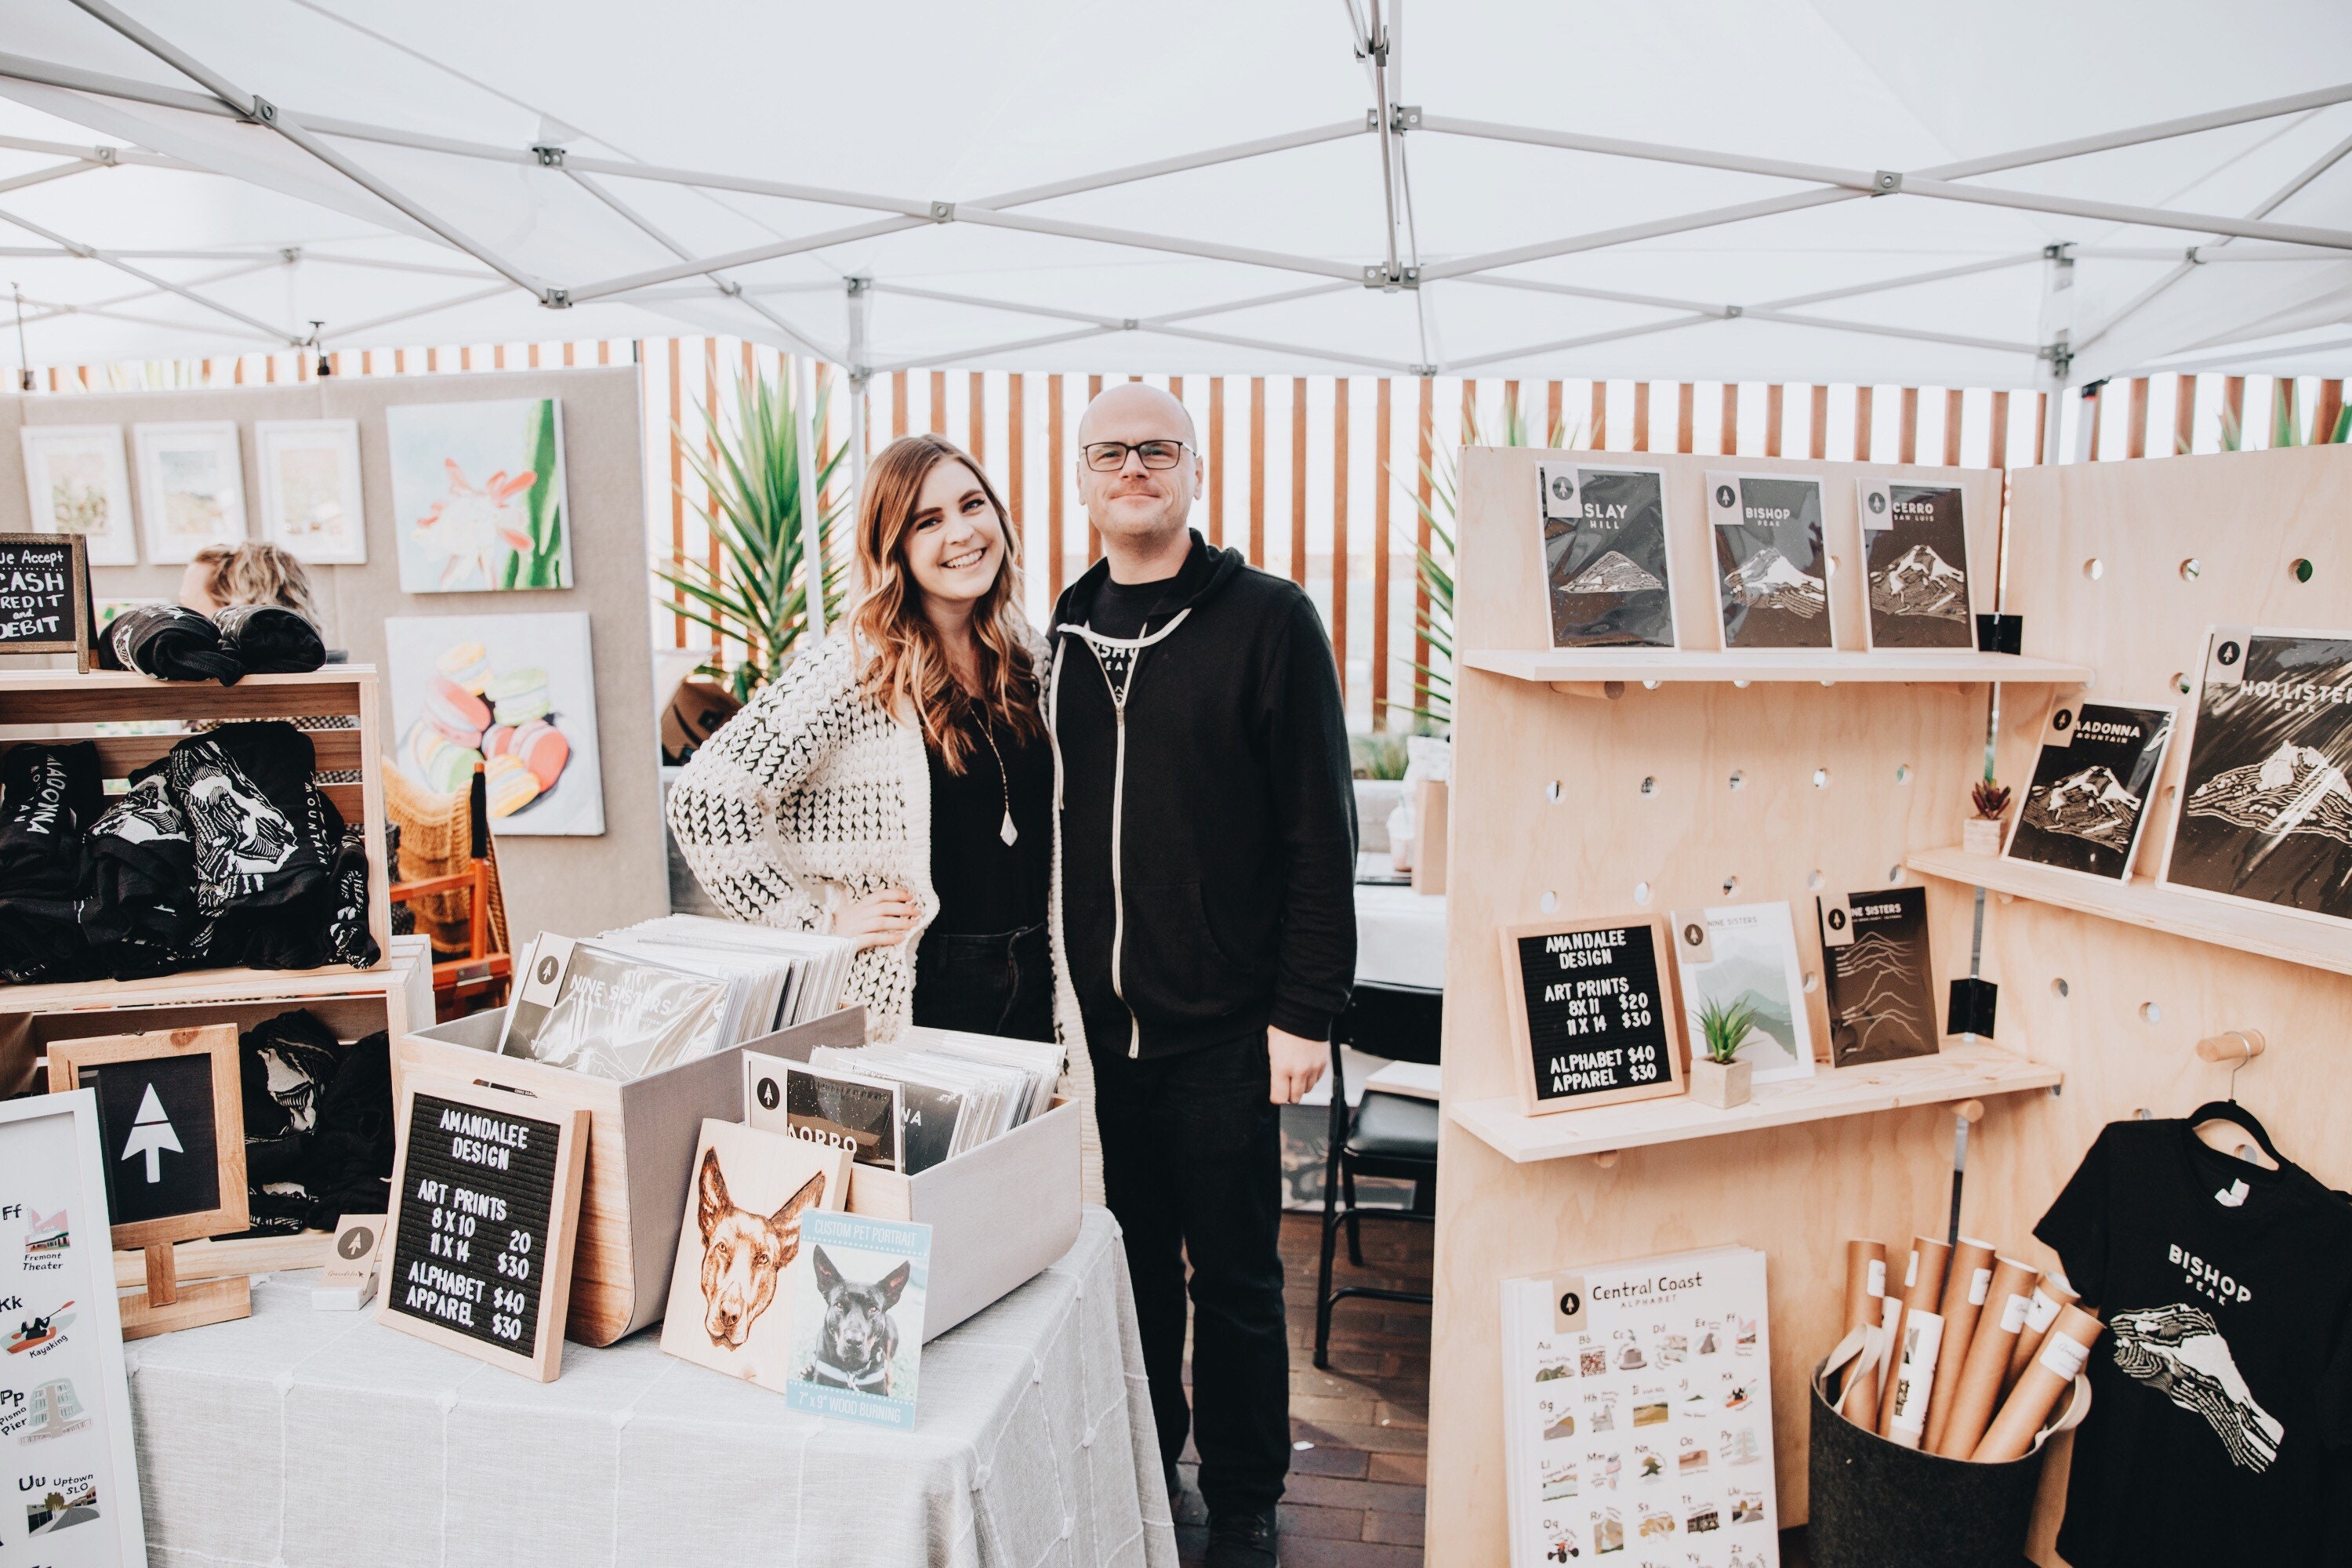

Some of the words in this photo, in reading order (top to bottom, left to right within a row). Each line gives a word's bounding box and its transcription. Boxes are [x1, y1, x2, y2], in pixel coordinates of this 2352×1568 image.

[1585, 503, 1628, 519] SLAY
[1745, 507, 1791, 521] BISHOP
[1893, 503, 1934, 514] CERRO
[1590, 521, 1619, 529] HILL
[21, 550, 64, 567] Accept
[0, 594, 64, 608] REDIT
[13, 608, 34, 619] and
[2274, 701, 2315, 713] PEAK
[1545, 930, 1627, 953] AMANDALEE
[1559, 949, 1612, 969] DESIGN
[569, 973, 606, 998] NINE
[608, 985, 672, 1016] SISTERS
[1544, 982, 1572, 1002] ART
[1577, 977, 1630, 999] PRINTS
[1619, 993, 1649, 1011] $20
[1621, 1010, 1652, 1029] $30
[1550, 1048, 1623, 1074] ALPHABET
[1628, 1045, 1655, 1064] $40
[1552, 1068, 1617, 1092] APPAREL
[1629, 1062, 1657, 1082] $30
[440, 1108, 529, 1150] AMANDALEE
[452, 1137, 510, 1171] DESIGN
[417, 1178, 448, 1205] ART
[454, 1188, 507, 1221] PRINTS
[2, 1204, 22, 1221] Ff
[509, 1229, 532, 1254] 20
[815, 1219, 851, 1239] CUSTOM
[853, 1224, 871, 1241] PET
[873, 1229, 916, 1247] PORTRAIT
[23, 1261, 64, 1271] Theater
[24, 1252, 62, 1261] Fremont
[497, 1252, 530, 1280] $30
[2169, 1243, 2252, 1302] BISHOP
[408, 1261, 486, 1304] ALPHABET
[493, 1287, 525, 1316] $40
[1593, 1279, 1652, 1301] Central
[1659, 1272, 1703, 1291] Coast
[2185, 1275, 2226, 1306] PEAK
[405, 1285, 475, 1327] APPAREL
[492, 1312, 522, 1341] $30
[29, 1334, 69, 1358] Kayaking
[0, 1389, 24, 1406] Pp
[829, 1397, 858, 1414] WOOD
[859, 1402, 901, 1423] BURNING
[1, 1417, 27, 1436] Pier
[19, 1475, 46, 1491] Uu
[53, 1473, 93, 1486] Uptown
[66, 1483, 89, 1495] SLO
